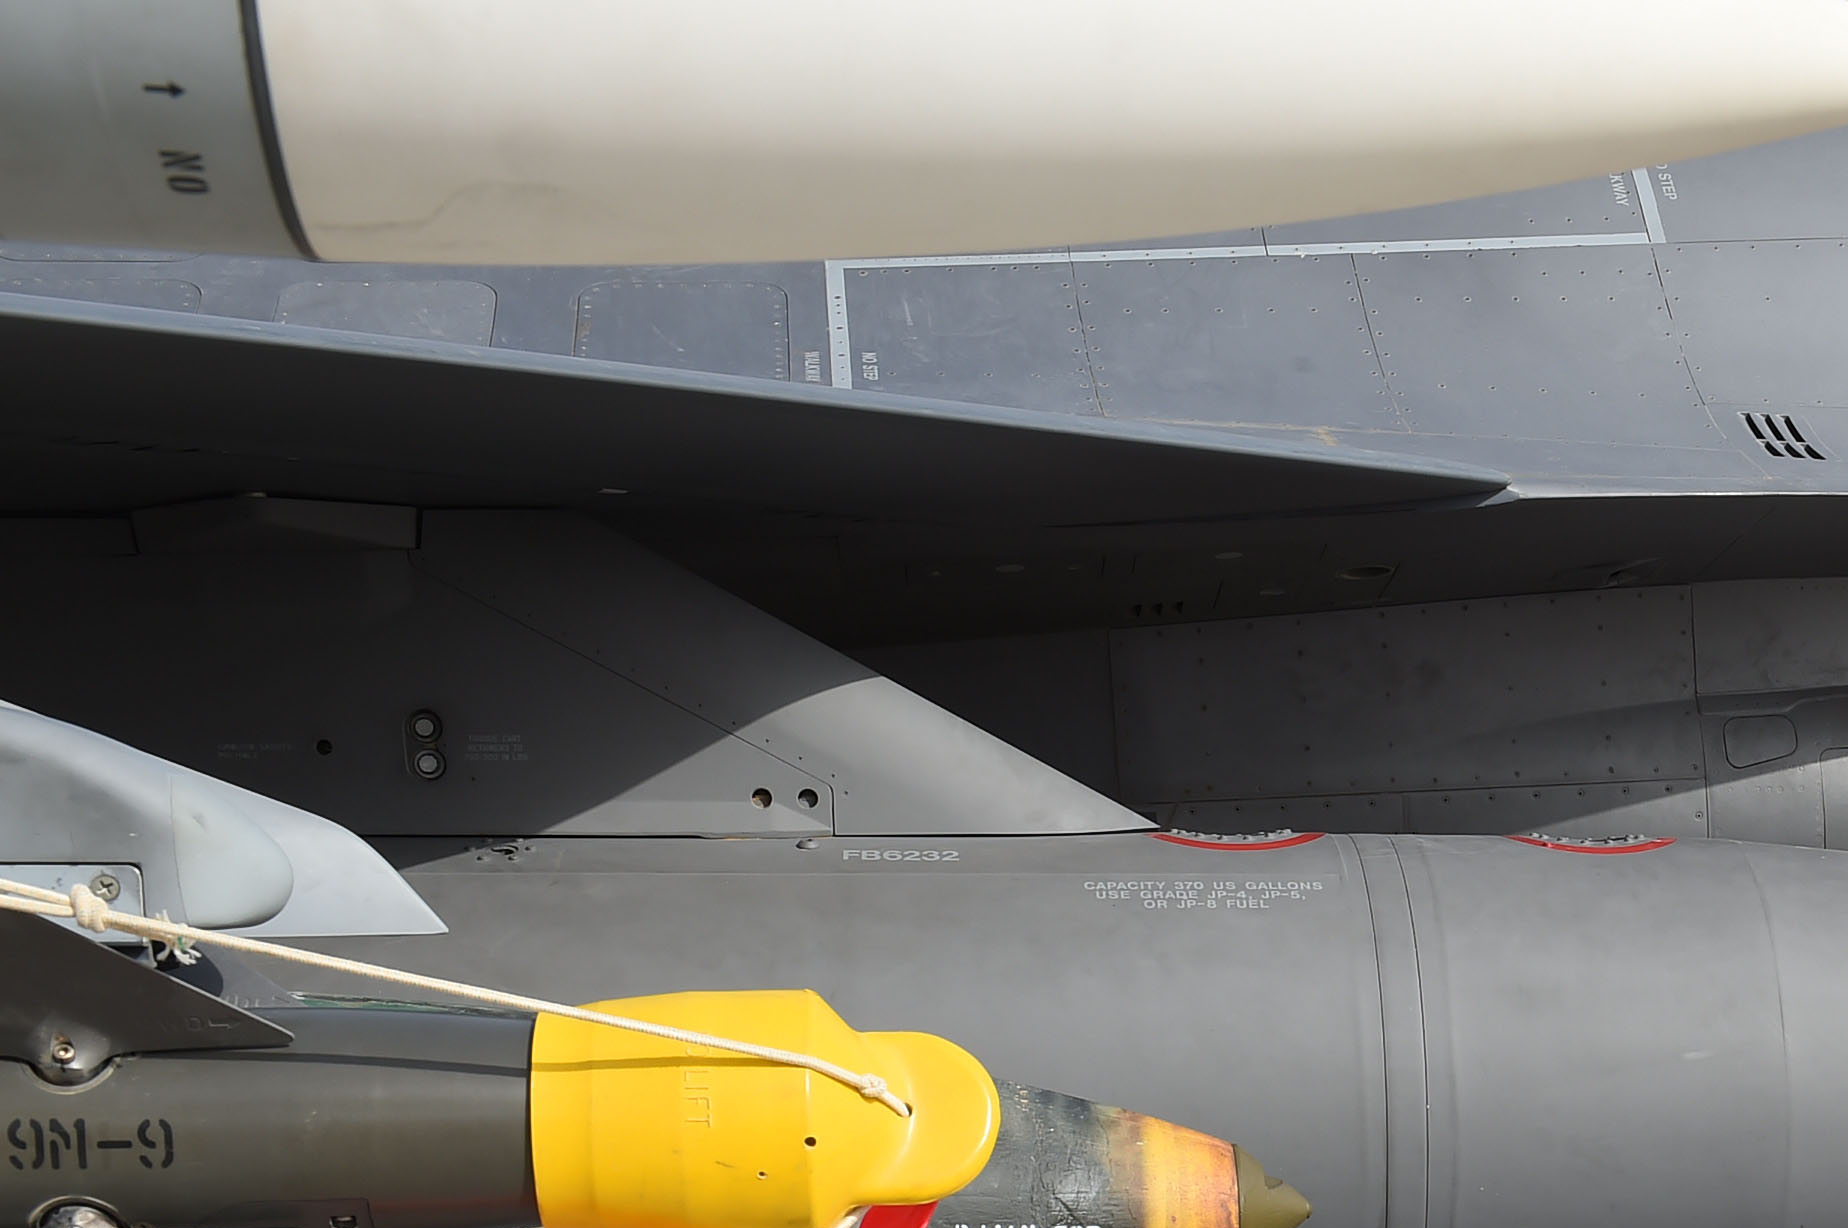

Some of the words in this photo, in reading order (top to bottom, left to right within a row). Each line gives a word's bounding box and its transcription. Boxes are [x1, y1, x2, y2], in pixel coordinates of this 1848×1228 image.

[1608, 173, 1630, 206] KWAY
[1657, 173, 1679, 201] STEP
[861, 352, 878, 363] NO
[862, 365, 879, 381] STEP
[842, 849, 960, 862] FB6232
[1083, 881, 1166, 890] CAPACITY
[1174, 881, 1204, 890] 370
[1213, 881, 1236, 890] US
[1244, 881, 1324, 890] GALLONS
[1096, 890, 1131, 899] USE
[1140, 890, 1199, 899] GRADE
[1207, 890, 1252, 901] JP-4,
[1261, 890, 1307, 901] JP-5,
[1143, 900, 1169, 909] OR
[1176, 900, 1217, 909] JP-8
[1226, 900, 1270, 909] FUEL
[680, 1070, 713, 1129] LIFT
